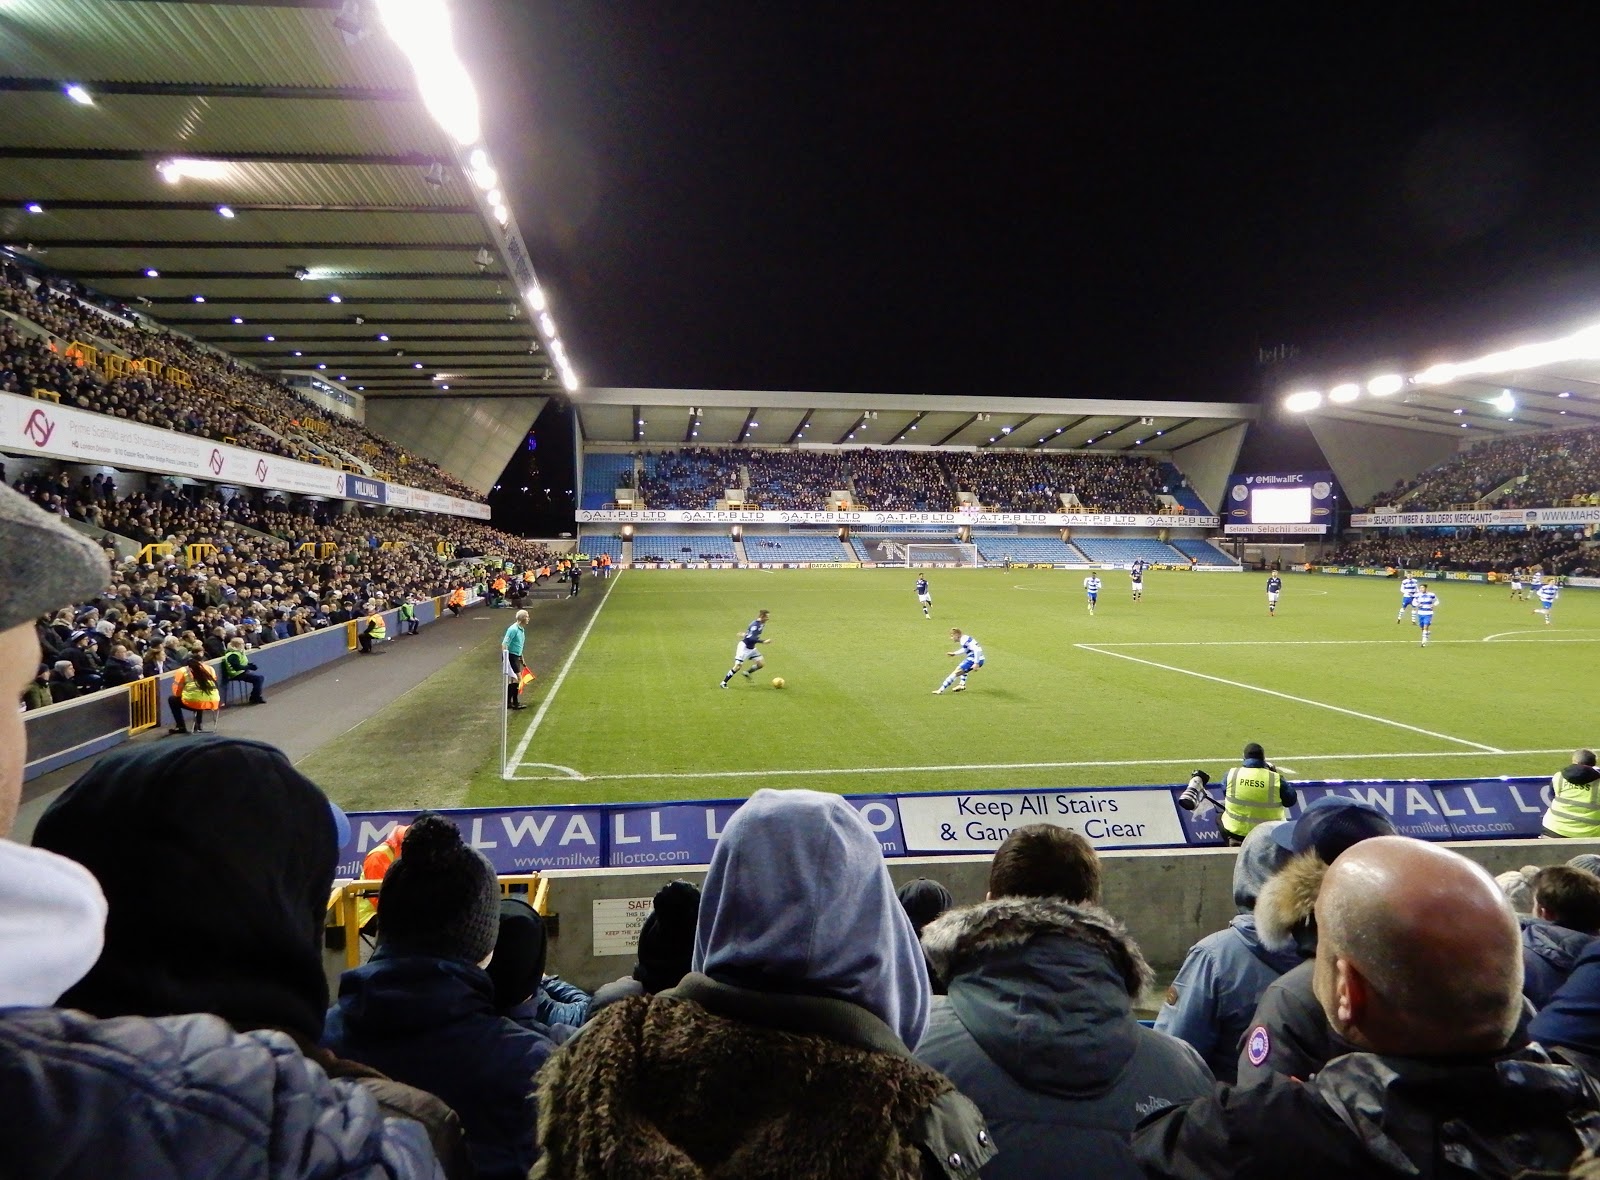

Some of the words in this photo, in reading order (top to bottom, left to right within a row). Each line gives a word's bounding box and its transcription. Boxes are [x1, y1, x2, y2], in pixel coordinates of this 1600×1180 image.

[1255, 474, 1303, 484] @MillwallFC
[1398, 515, 1418, 524] TIMBER
[1257, 525, 1291, 533] Selachii
[1446, 572, 1483, 581] bet365.com
[1239, 778, 1265, 789] PRESS
[957, 797, 1014, 821] Keep
[1020, 795, 1049, 815] All
[1055, 794, 1119, 815] Stairs
[357, 811, 678, 853] MLWALL
[940, 823, 958, 841] &
[1084, 818, 1146, 839] Clear
[628, 900, 653, 910] SAF
